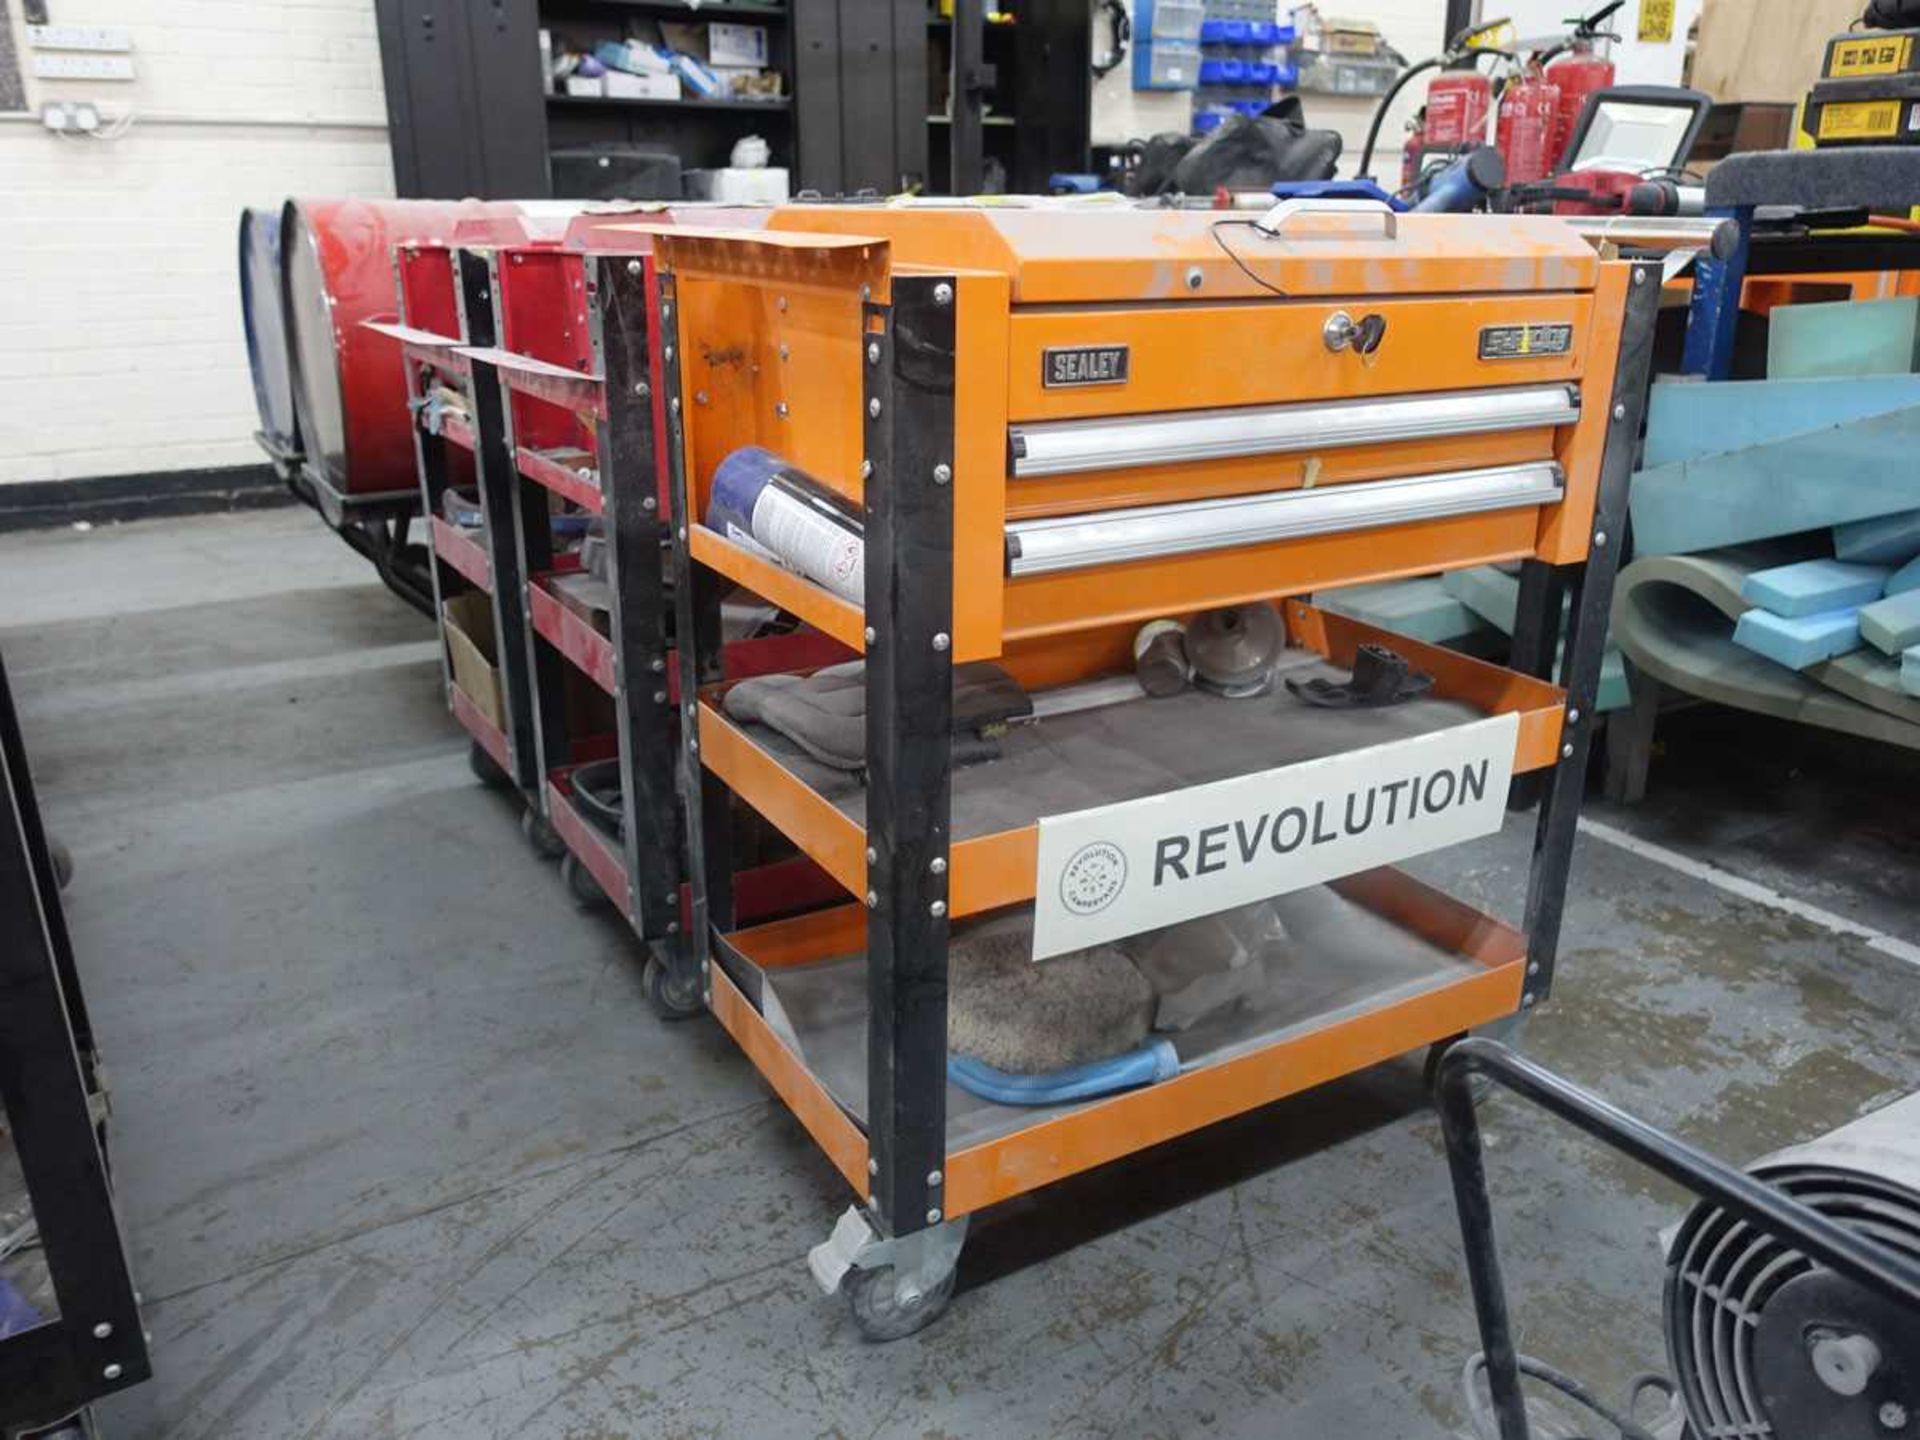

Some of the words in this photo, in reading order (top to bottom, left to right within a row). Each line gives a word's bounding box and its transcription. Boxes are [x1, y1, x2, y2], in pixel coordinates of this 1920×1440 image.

[1054, 352, 1121, 381] SEALEY
[1152, 759, 1489, 887] REVOLUTION
[1069, 848, 1119, 877] REVOLUTION
